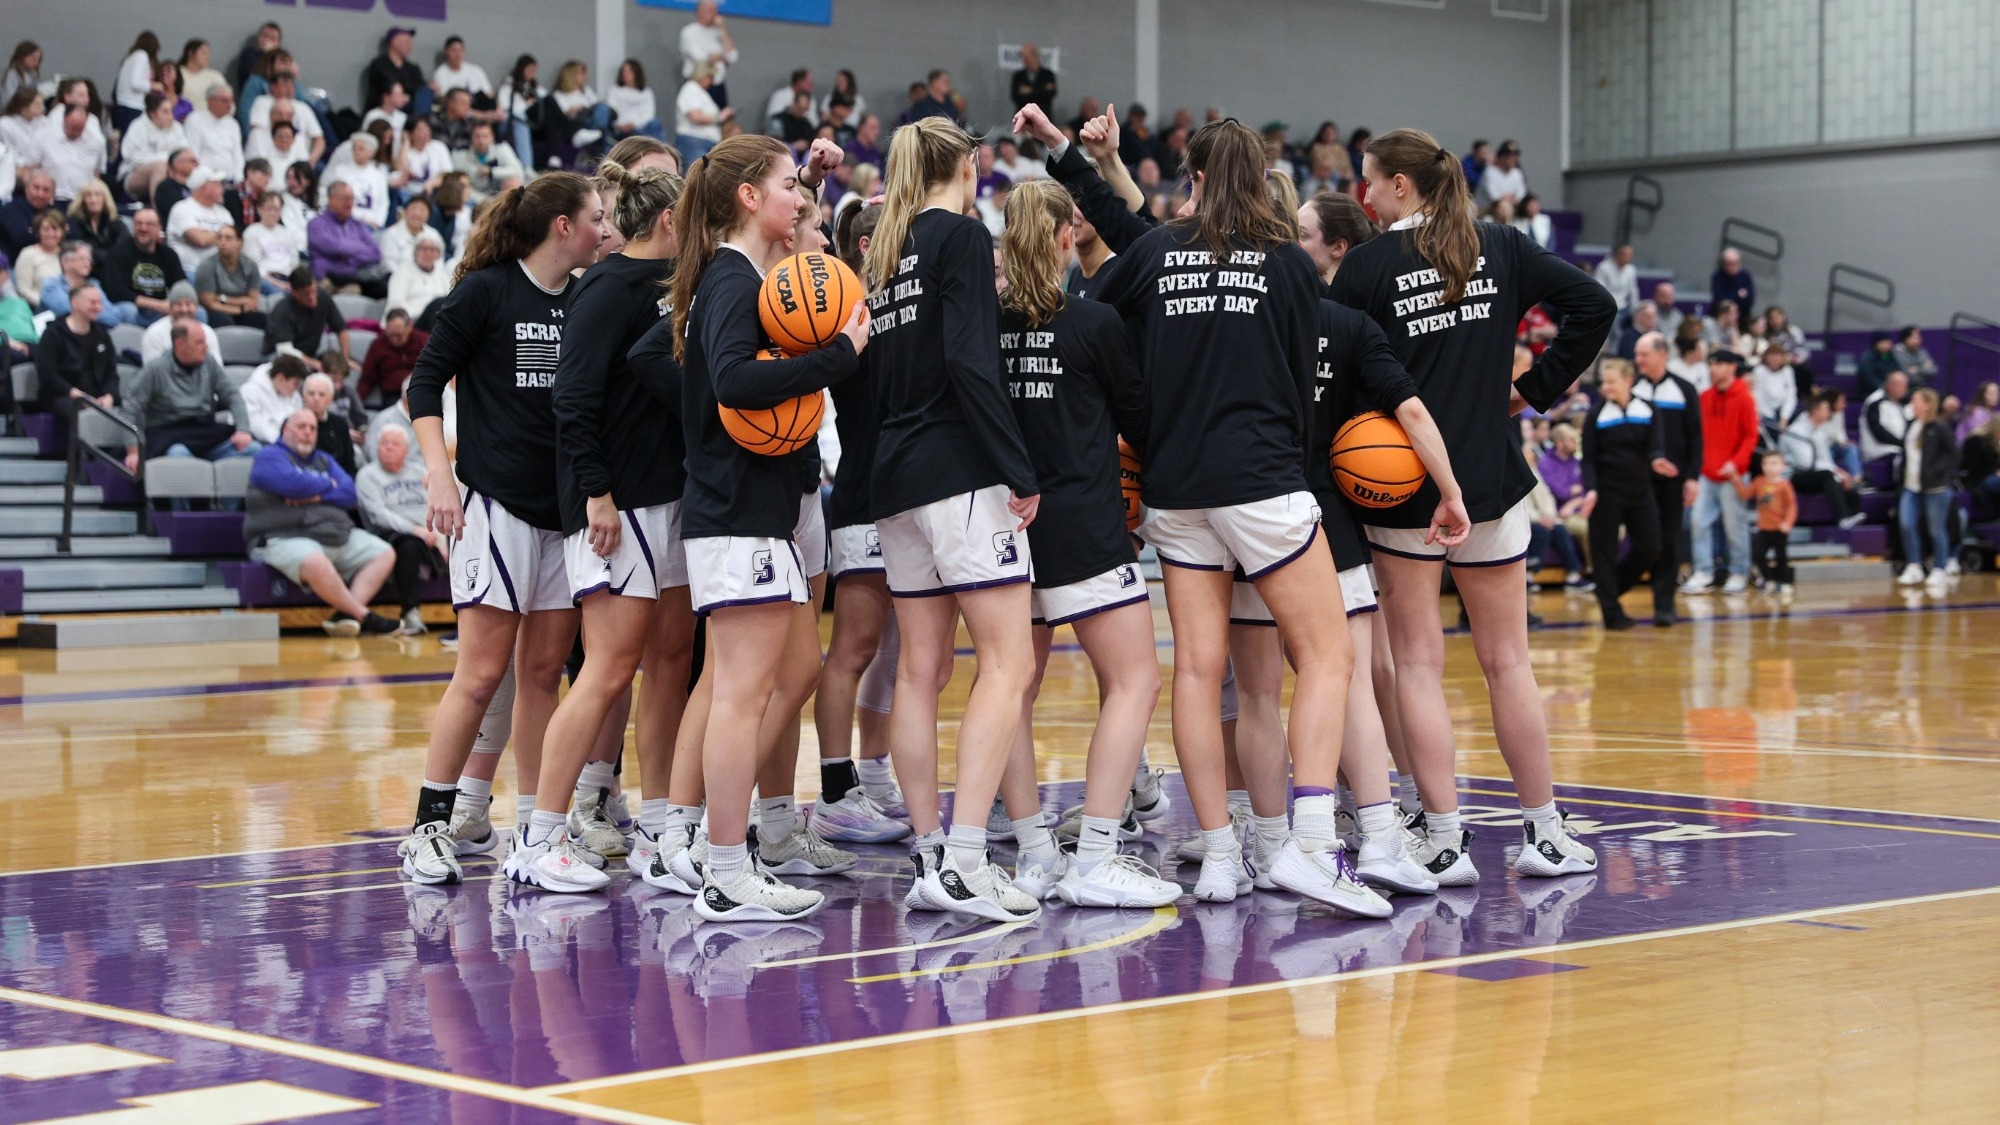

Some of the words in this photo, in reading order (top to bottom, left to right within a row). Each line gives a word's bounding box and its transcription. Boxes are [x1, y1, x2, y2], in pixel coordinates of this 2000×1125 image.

[898, 254, 919, 275] REP
[776, 266, 799, 315] NCAA
[805, 255, 831, 316] Wilson
[1157, 272, 1211, 295] EVERY
[1216, 270, 1269, 294] DRILL
[1395, 267, 1445, 292] EVER
[1463, 278, 1498, 298] RILL
[868, 287, 890, 311] ERY
[894, 278, 923, 302] DRILL
[1164, 294, 1218, 317] EVERY
[1223, 294, 1259, 315] DAY
[869, 310, 897, 337] EVERY
[899, 303, 918, 326] DAY
[1406, 310, 1457, 338] EVERY
[1460, 302, 1492, 322] DAY
[1025, 331, 1055, 349] REP
[1019, 356, 1063, 375] DRILL
[1025, 381, 1054, 399] DAY
[1353, 482, 1414, 502] Wilson
